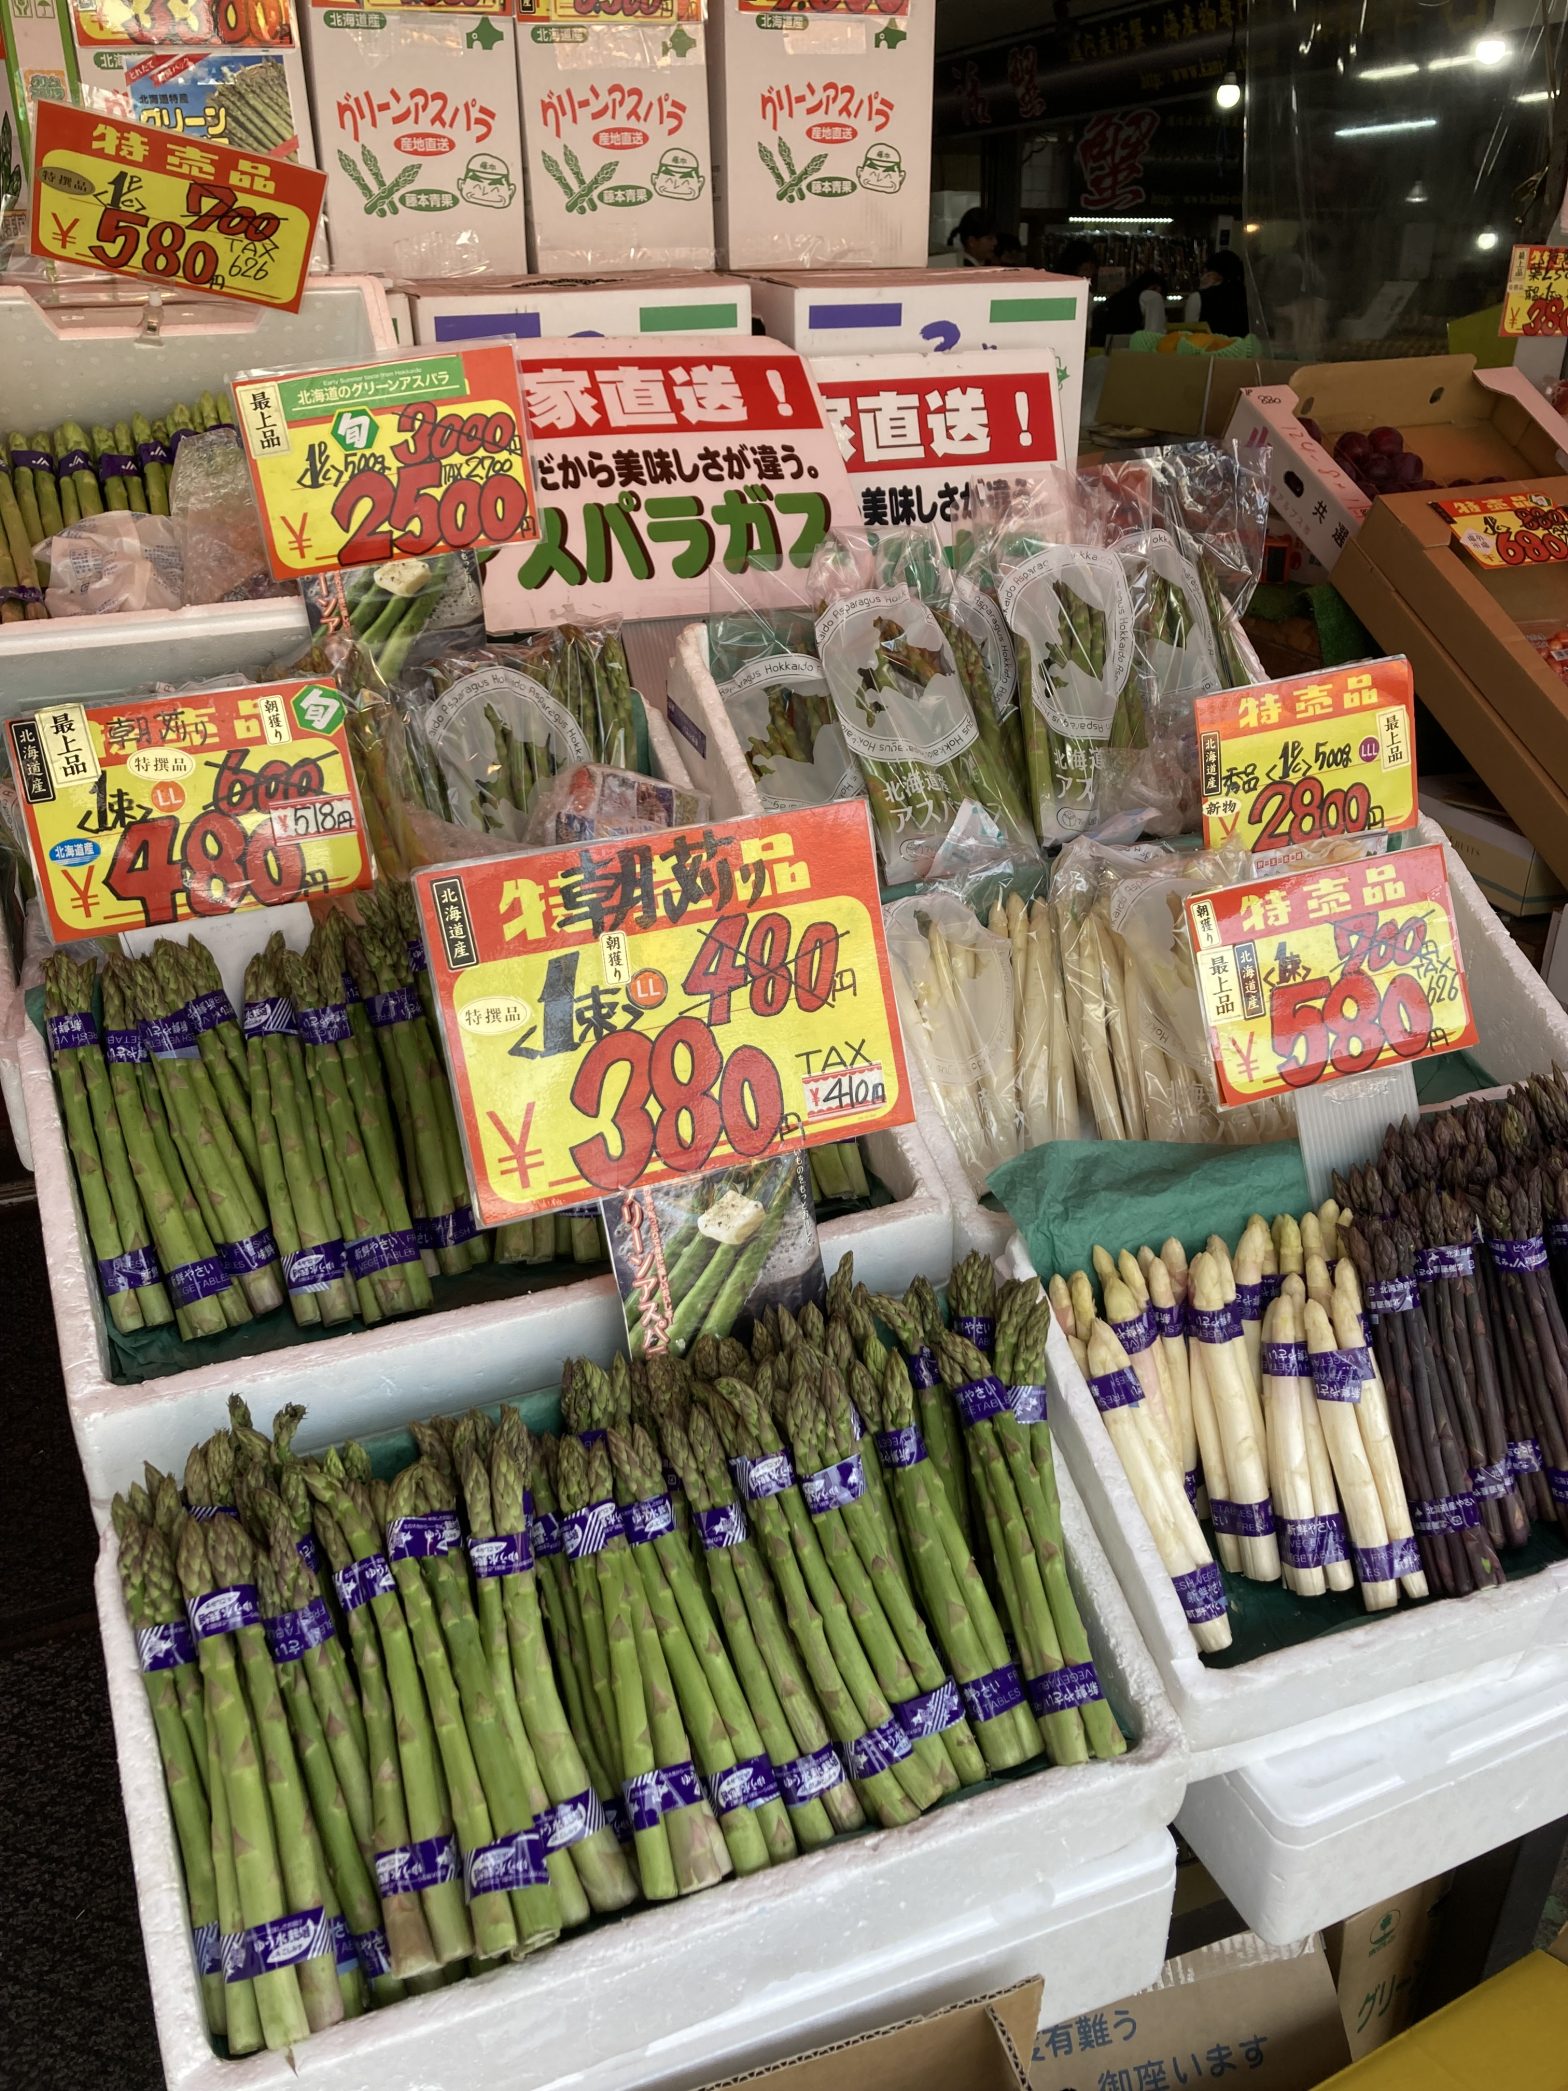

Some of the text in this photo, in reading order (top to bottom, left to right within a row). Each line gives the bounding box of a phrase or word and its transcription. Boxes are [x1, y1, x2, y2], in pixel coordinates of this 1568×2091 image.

[331, 13, 383, 28] 北海道産
[140, 107, 227, 136] グリーン
[336, 87, 497, 144] グリーンアスパラ
[541, 83, 687, 139] グリーンアスパラ
[760, 81, 895, 132] グリーンアスパラ
[400, 136, 450, 152] 産地直送
[598, 131, 645, 146] 産地直送
[810, 125, 853, 141] 産地直送
[92, 123, 277, 195] 特売品
[296, 370, 450, 407] 北海道のグリーンアスパラ
[250, 390, 281, 449] 最上品
[337, 411, 371, 449] 旬
[484, 482, 833, 591] スパラガス
[1496, 529, 1568, 566] 680
[262, 698, 286, 743] 朝獲り
[299, 688, 339, 730] 旬
[1237, 672, 1379, 730] 特売品
[18, 727, 48, 796] 北海道産
[49, 711, 88, 778] 最上品
[1360, 743, 1378, 757] LLL
[1384, 716, 1404, 764] 最上品
[133, 755, 188, 774] 特撰品
[1204, 737, 1219, 791] 北海道産
[155, 790, 183, 808] LL
[1205, 799, 1239, 816] 新物
[53, 840, 97, 862] 北海道産
[1240, 863, 1407, 931] 特売品
[440, 886, 470, 961] 北海道産
[1195, 904, 1214, 945] 朝獲り
[605, 934, 625, 983] 朝獲り
[635, 983, 661, 999] LL
[1208, 957, 1235, 1016] 最上品
[1238, 952, 1260, 1011] 北海道産
[464, 1007, 522, 1027] 特撰品
[795, 1037, 873, 1076] TAX
[1031, 2008, 1138, 2062] 有難う
